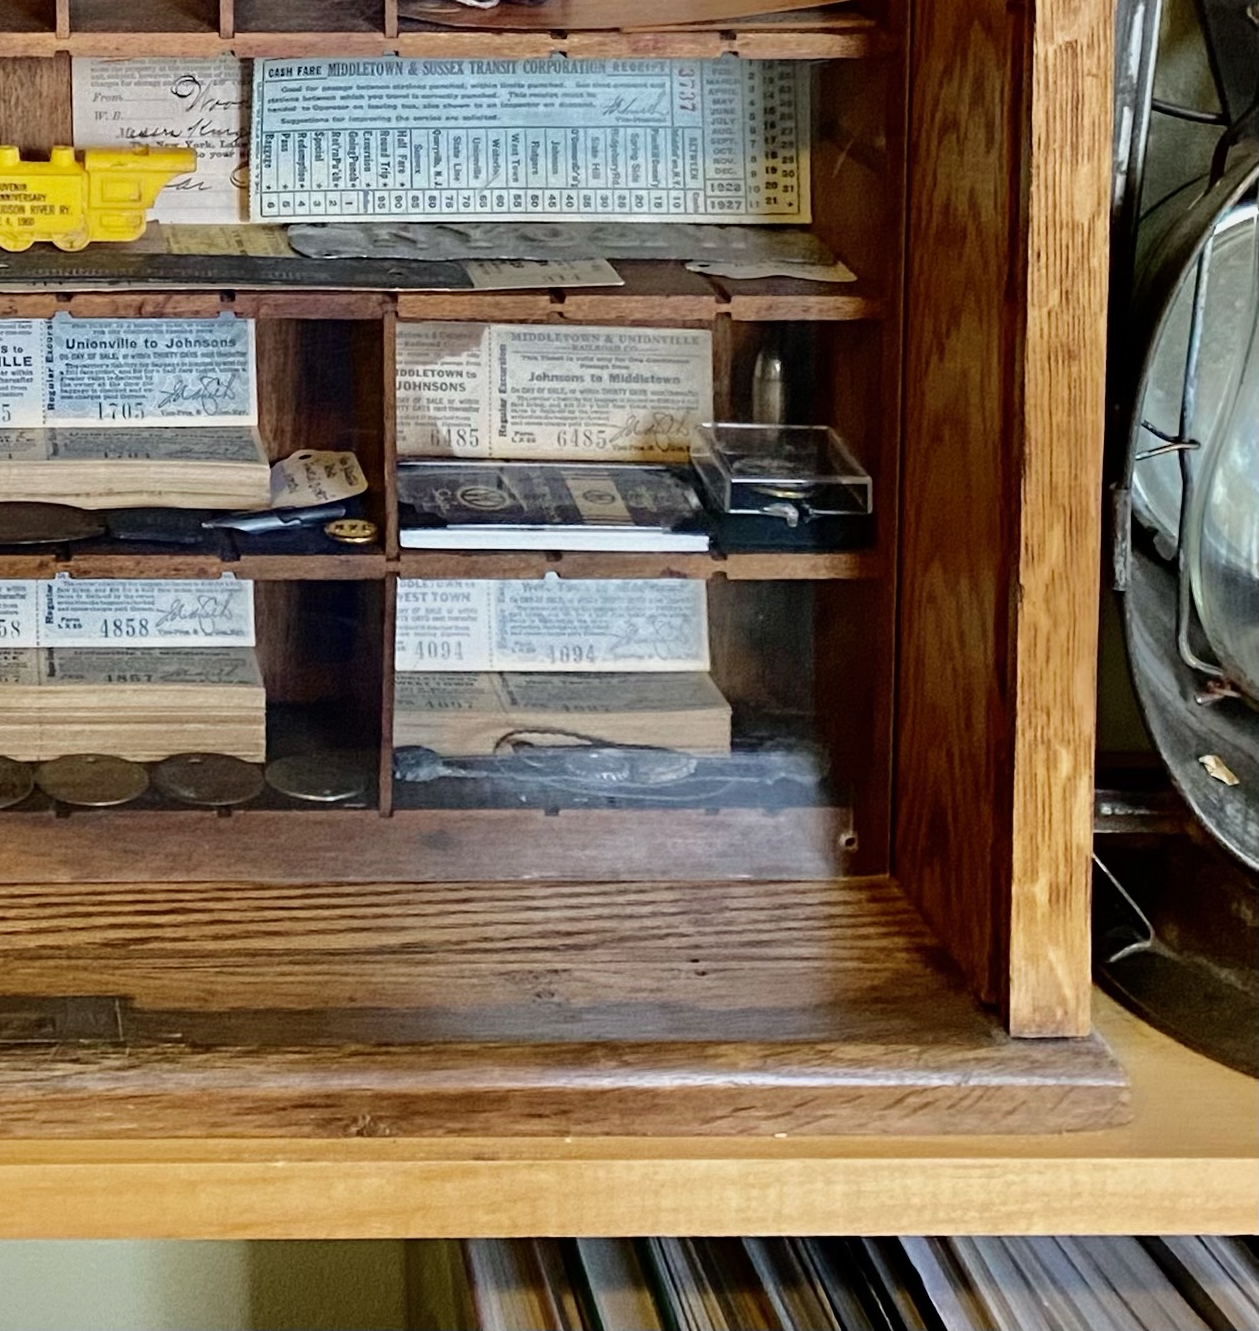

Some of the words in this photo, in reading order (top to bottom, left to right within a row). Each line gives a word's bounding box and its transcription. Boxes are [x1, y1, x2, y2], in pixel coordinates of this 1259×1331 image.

[269, 67, 293, 78] CASH
[297, 66, 322, 76] FARE
[327, 62, 403, 77] MIDDLETOWN
[408, 61, 418, 76] &
[422, 61, 465, 76] SUSSEX
[470, 60, 518, 75] TRANSIT
[95, 112, 108, 120] W.
[30, 205, 55, 215] RIVER
[65, 338, 137, 350] Unionville
[145, 338, 158, 349] to
[165, 338, 237, 349] Johnsons
[466, 371, 477, 379] to
[499, 343, 507, 395] Excursion
[528, 372, 586, 383] Johnsons
[591, 373, 603, 383] to
[609, 373, 682, 384] Middletown
[46, 369, 55, 411] Regular
[98, 402, 145, 419] 1705
[557, 429, 607, 449] 6485
[45, 585, 54, 626] Regular
[431, 592, 471, 603] TOWN
[100, 618, 149, 638] 4858
